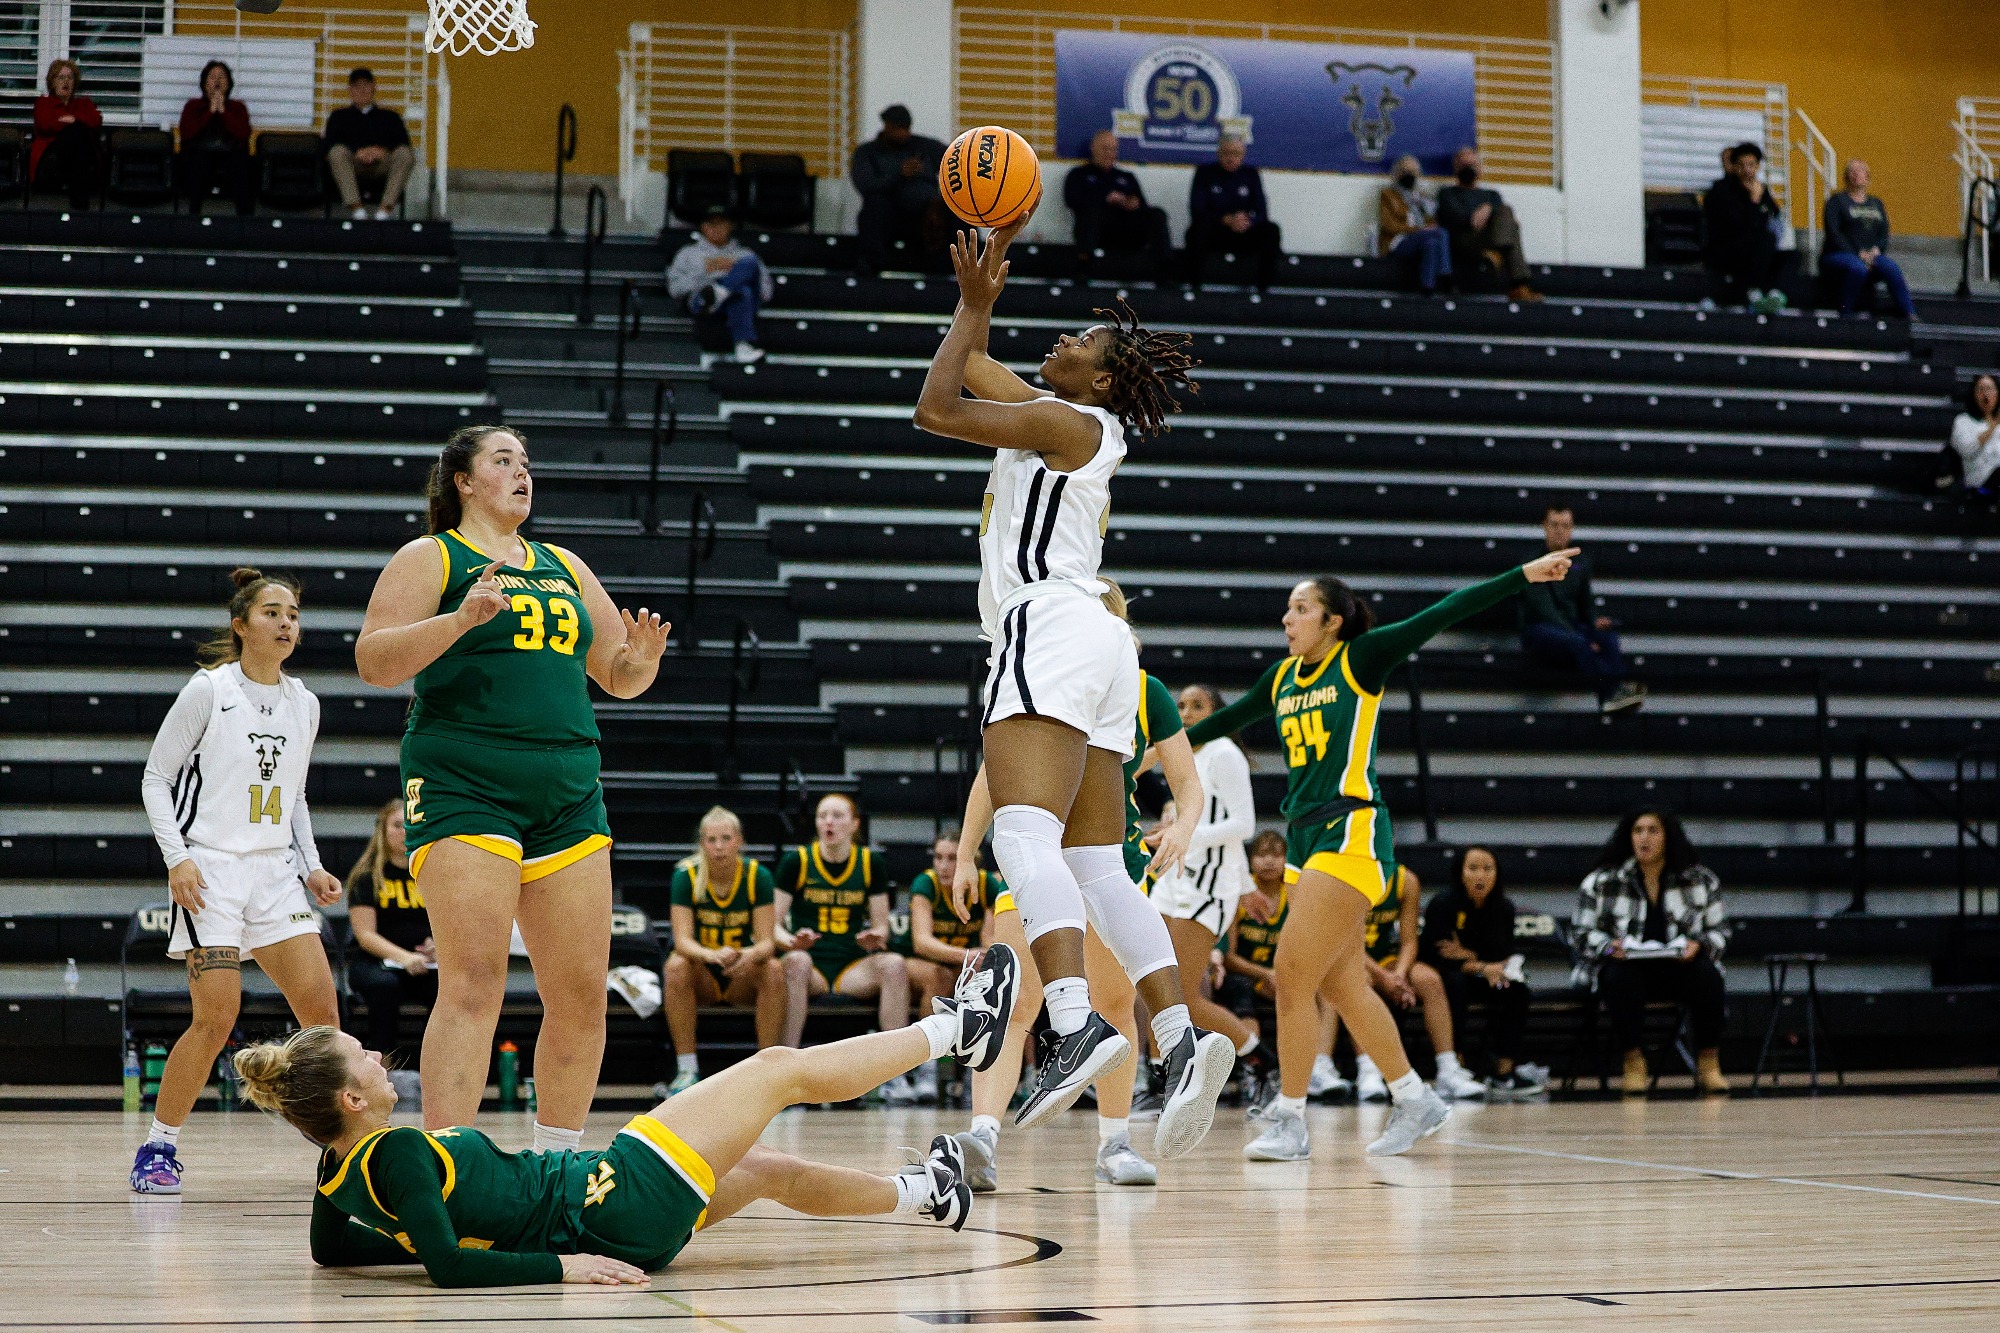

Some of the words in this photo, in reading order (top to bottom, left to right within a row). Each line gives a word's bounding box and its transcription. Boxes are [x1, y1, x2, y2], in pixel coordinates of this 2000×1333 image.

[1153, 77, 1212, 121] 50
[977, 135, 996, 180] NCAA
[491, 574, 532, 590] OINT
[530, 578, 577, 597] LOMA
[511, 594, 579, 655] 33
[1302, 685, 1338, 709] LOMA
[1281, 709, 1331, 768] 24
[248, 784, 282, 824] 14
[378, 879, 426, 909] PLN
[138, 909, 169, 931] UC
[818, 906, 850, 934] 15
